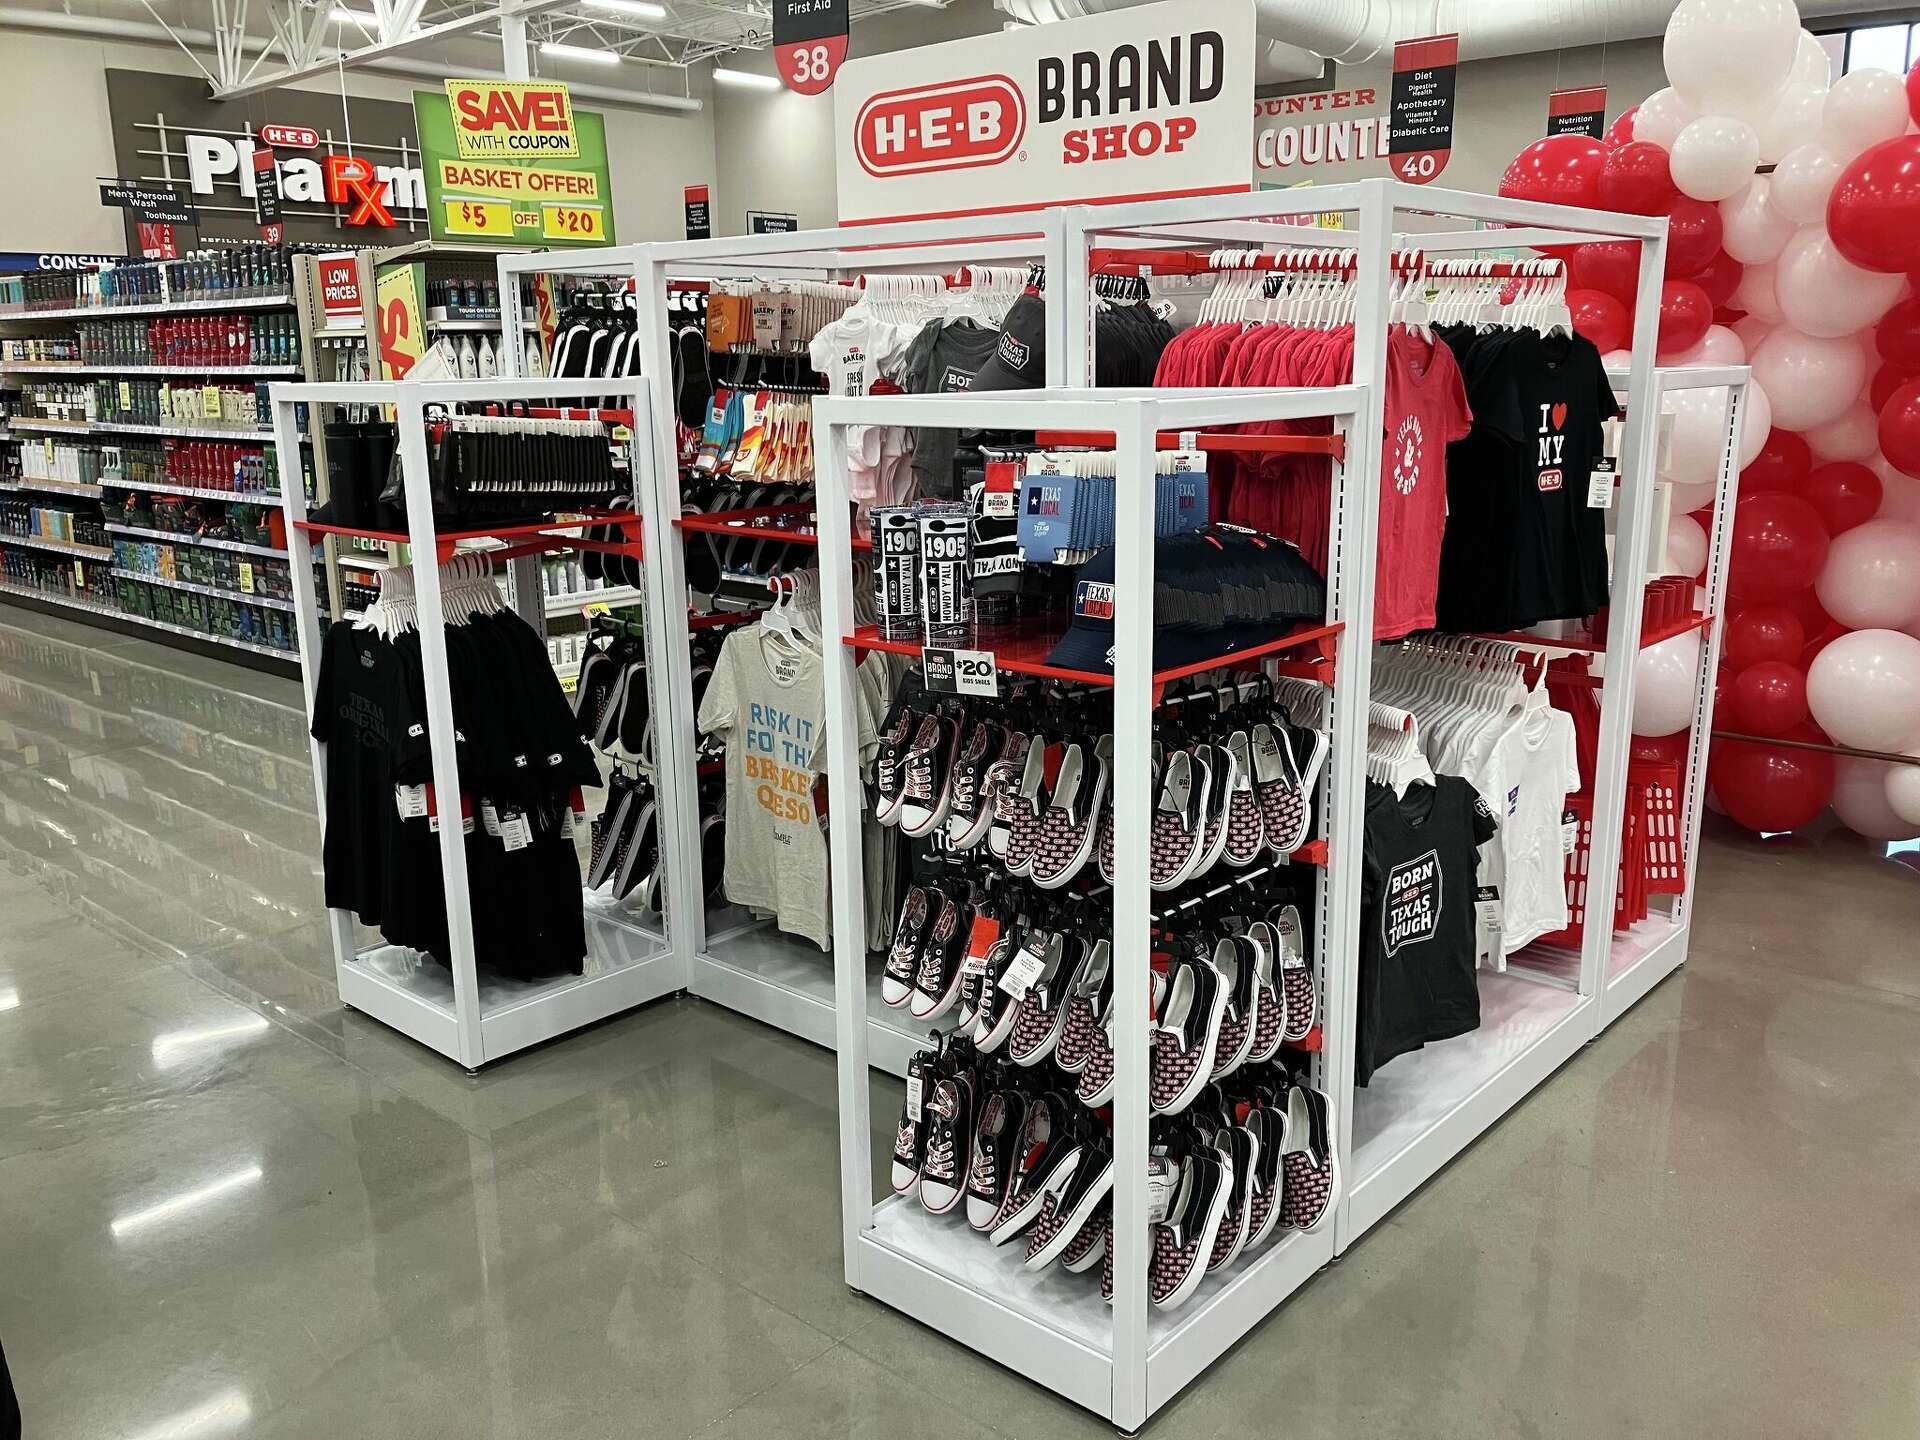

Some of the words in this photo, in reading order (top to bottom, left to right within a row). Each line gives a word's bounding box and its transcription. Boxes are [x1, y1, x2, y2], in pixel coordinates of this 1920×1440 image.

[788, 2, 811, 15] First
[792, 46, 830, 83] 38
[1038, 30, 1224, 124] BRAND
[1414, 72, 1432, 81] Diet
[1408, 82, 1438, 93] Digestive
[1412, 89, 1433, 97] Health
[457, 89, 569, 132] SAVE!
[1396, 98, 1447, 111] Apothecary
[1405, 111, 1432, 119] Vitamins
[1408, 116, 1434, 124] Minerals
[1558, 115, 1593, 125] Nutrition
[1392, 127, 1427, 138] Diabetic
[1429, 125, 1450, 134] Care
[466, 135, 505, 149] WITH
[509, 135, 570, 149] COUPON
[1063, 116, 1197, 164] SHOP
[1402, 154, 1435, 177] 40
[444, 166, 523, 189] BASKET
[528, 172, 595, 195] OFFER!
[107, 189, 133, 199] Men's
[136, 190, 176, 201] Personal
[130, 199, 157, 208] Wash
[144, 211, 188, 222] Toothpaste
[462, 202, 487, 228] $5
[514, 213, 538, 225] OFF
[557, 207, 594, 233] $20
[266, 228, 279, 243] 39
[328, 269, 349, 284] LOW
[325, 285, 357, 301] PRICES
[1003, 334, 1024, 357] TEXAS
[1000, 345, 1023, 367] TOUGH
[1538, 403, 1551, 434] I
[1538, 435, 1565, 466] MY
[1041, 487, 1061, 502] TEXAS
[1179, 484, 1196, 497] EXAS
[988, 499, 1009, 507] BRAND
[1040, 501, 1060, 516] LOCAL
[885, 530, 916, 552] 190
[926, 536, 966, 558] 1905
[942, 564, 951, 588] Y'ALL
[903, 582, 912, 613] HOWDY
[1088, 585, 1111, 601] TEXAS
[942, 589, 951, 621] HOWDY
[1086, 600, 1106, 616] LOCAL
[927, 663, 953, 674] BRAND
[956, 659, 992, 677] $20
[975, 678, 991, 686] SHOES
[750, 702, 791, 735] RISK
[796, 718, 813, 742] IT
[747, 728, 775, 753] FO
[1391, 861, 1434, 895] BORN
[1390, 894, 1431, 927] TEXAS
[1388, 912, 1433, 946] TOUGH
